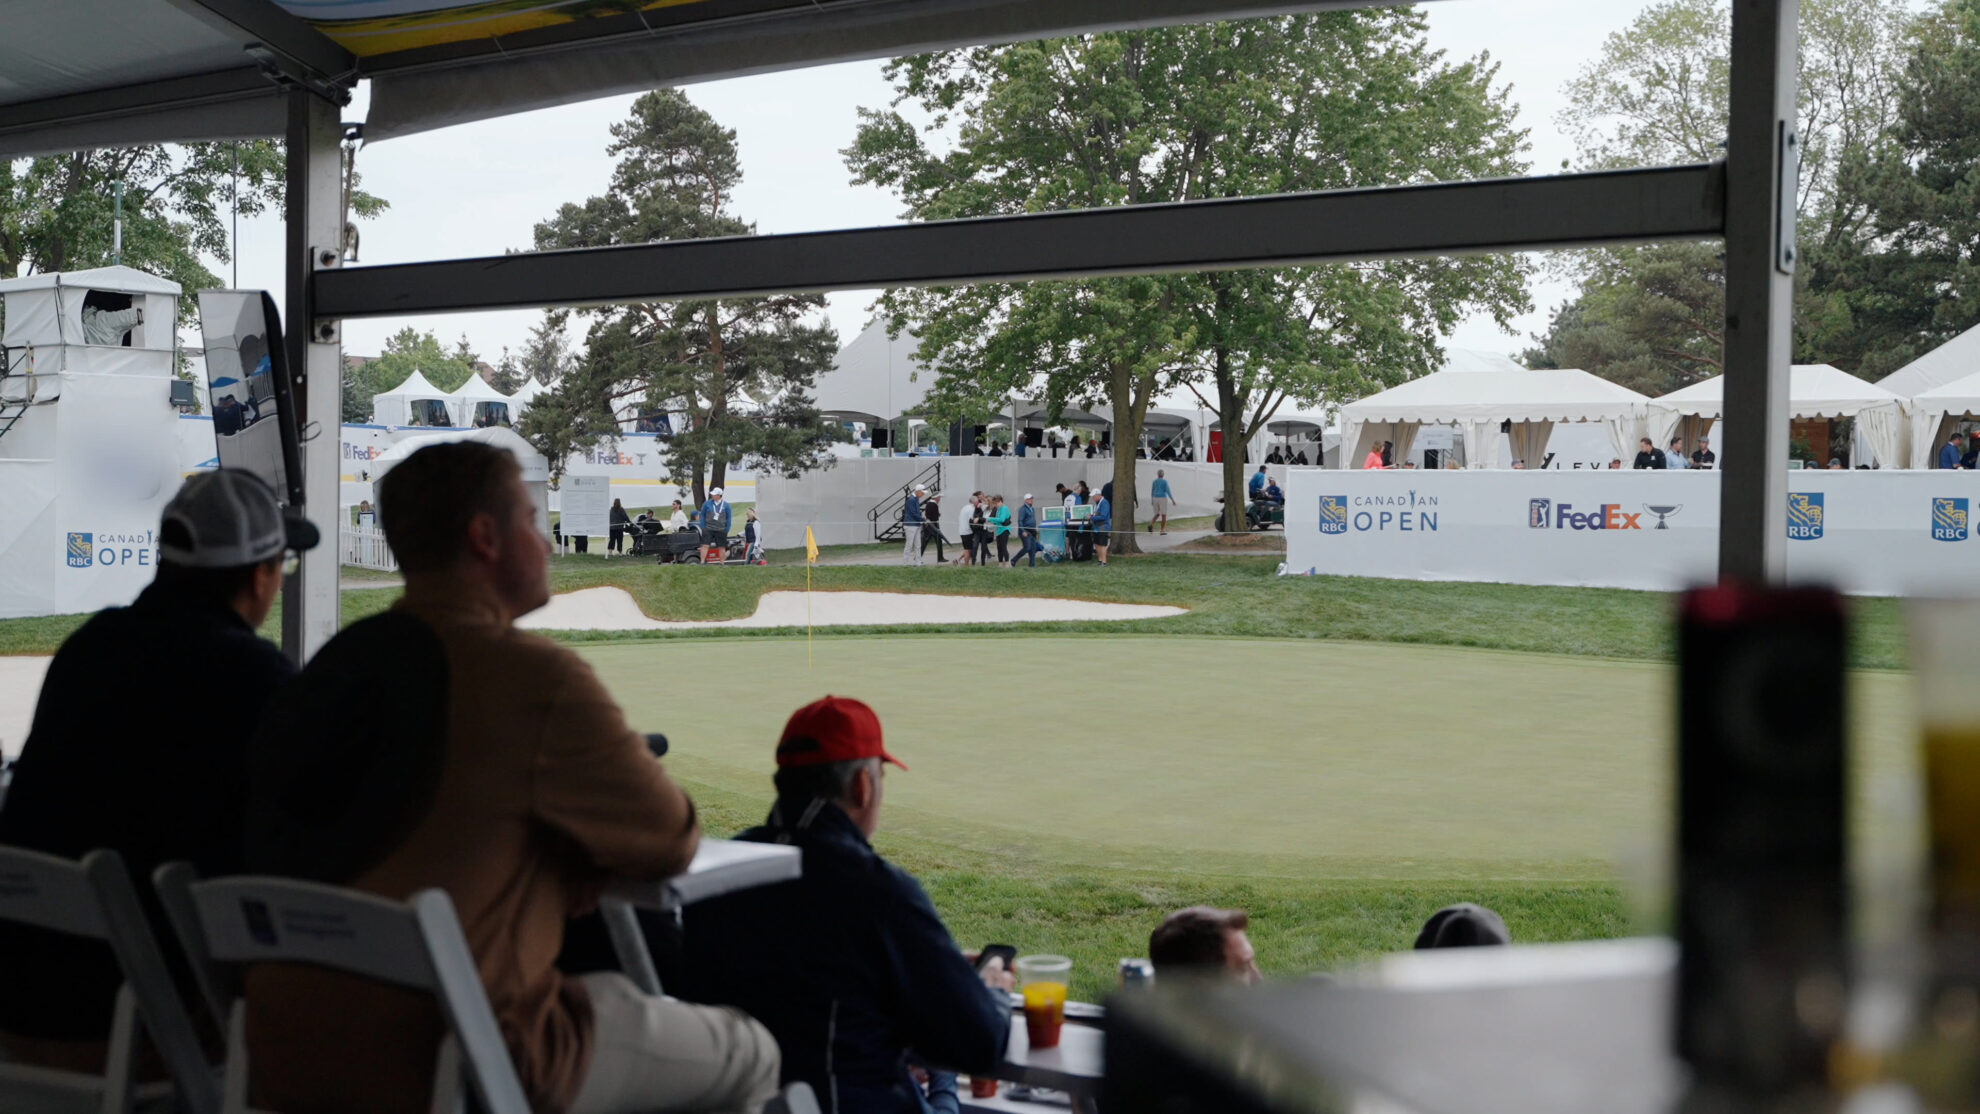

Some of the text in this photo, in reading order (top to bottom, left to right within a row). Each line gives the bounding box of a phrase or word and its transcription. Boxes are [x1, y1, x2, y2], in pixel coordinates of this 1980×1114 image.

[597, 451, 633, 465] FedEx
[1354, 492, 1438, 507] CANADIAN
[1353, 511, 1438, 531] OPEN
[1556, 503, 1641, 530] FedEx
[1321, 522, 1345, 532] RBC
[1788, 526, 1820, 537] RBC
[1935, 528, 1965, 539] RBC
[69, 557, 91, 566] RBC
